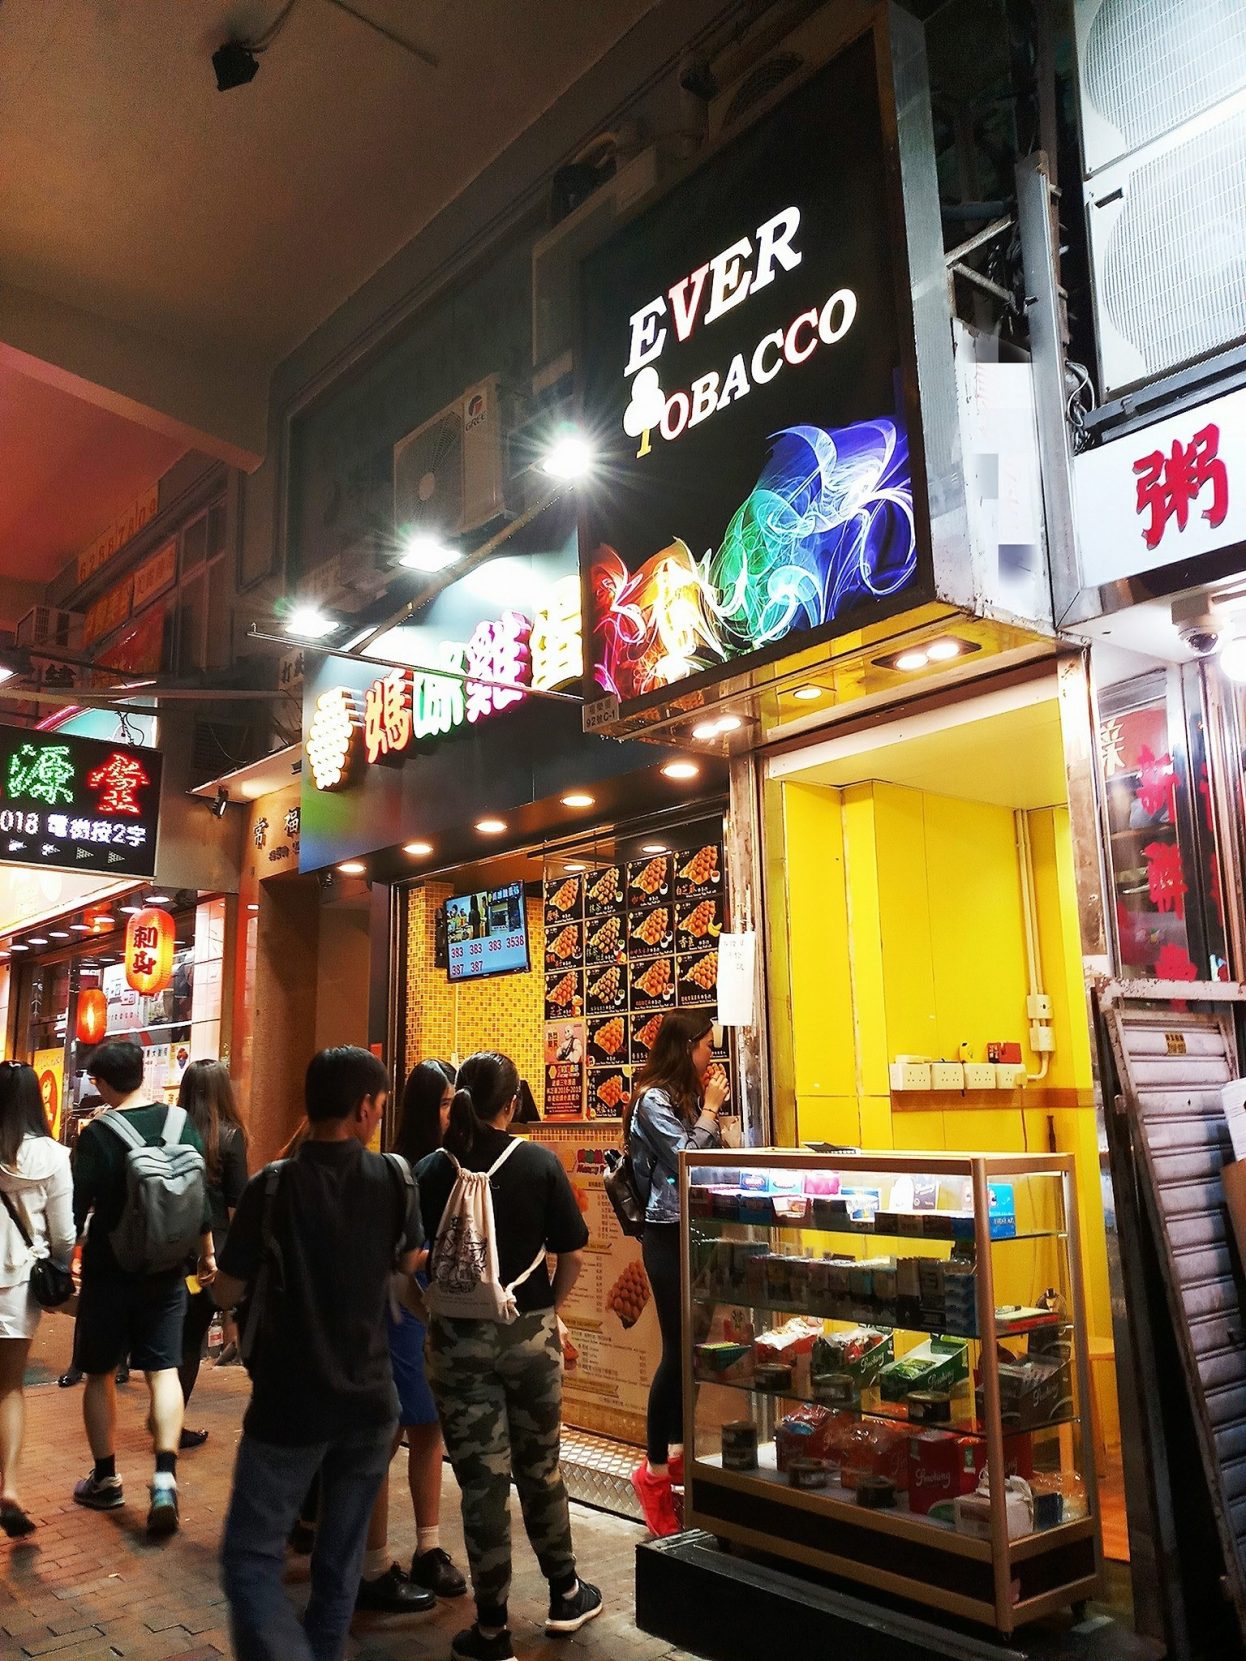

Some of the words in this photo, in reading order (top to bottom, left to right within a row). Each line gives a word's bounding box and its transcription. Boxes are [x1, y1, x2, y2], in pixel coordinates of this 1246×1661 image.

[624, 206, 802, 377] EVER
[623, 288, 857, 459] TOBACCO
[1132, 423, 1229, 551] 粥
[133, 926, 158, 975] 刺身
[914, 1467, 951, 1488] Smoking
